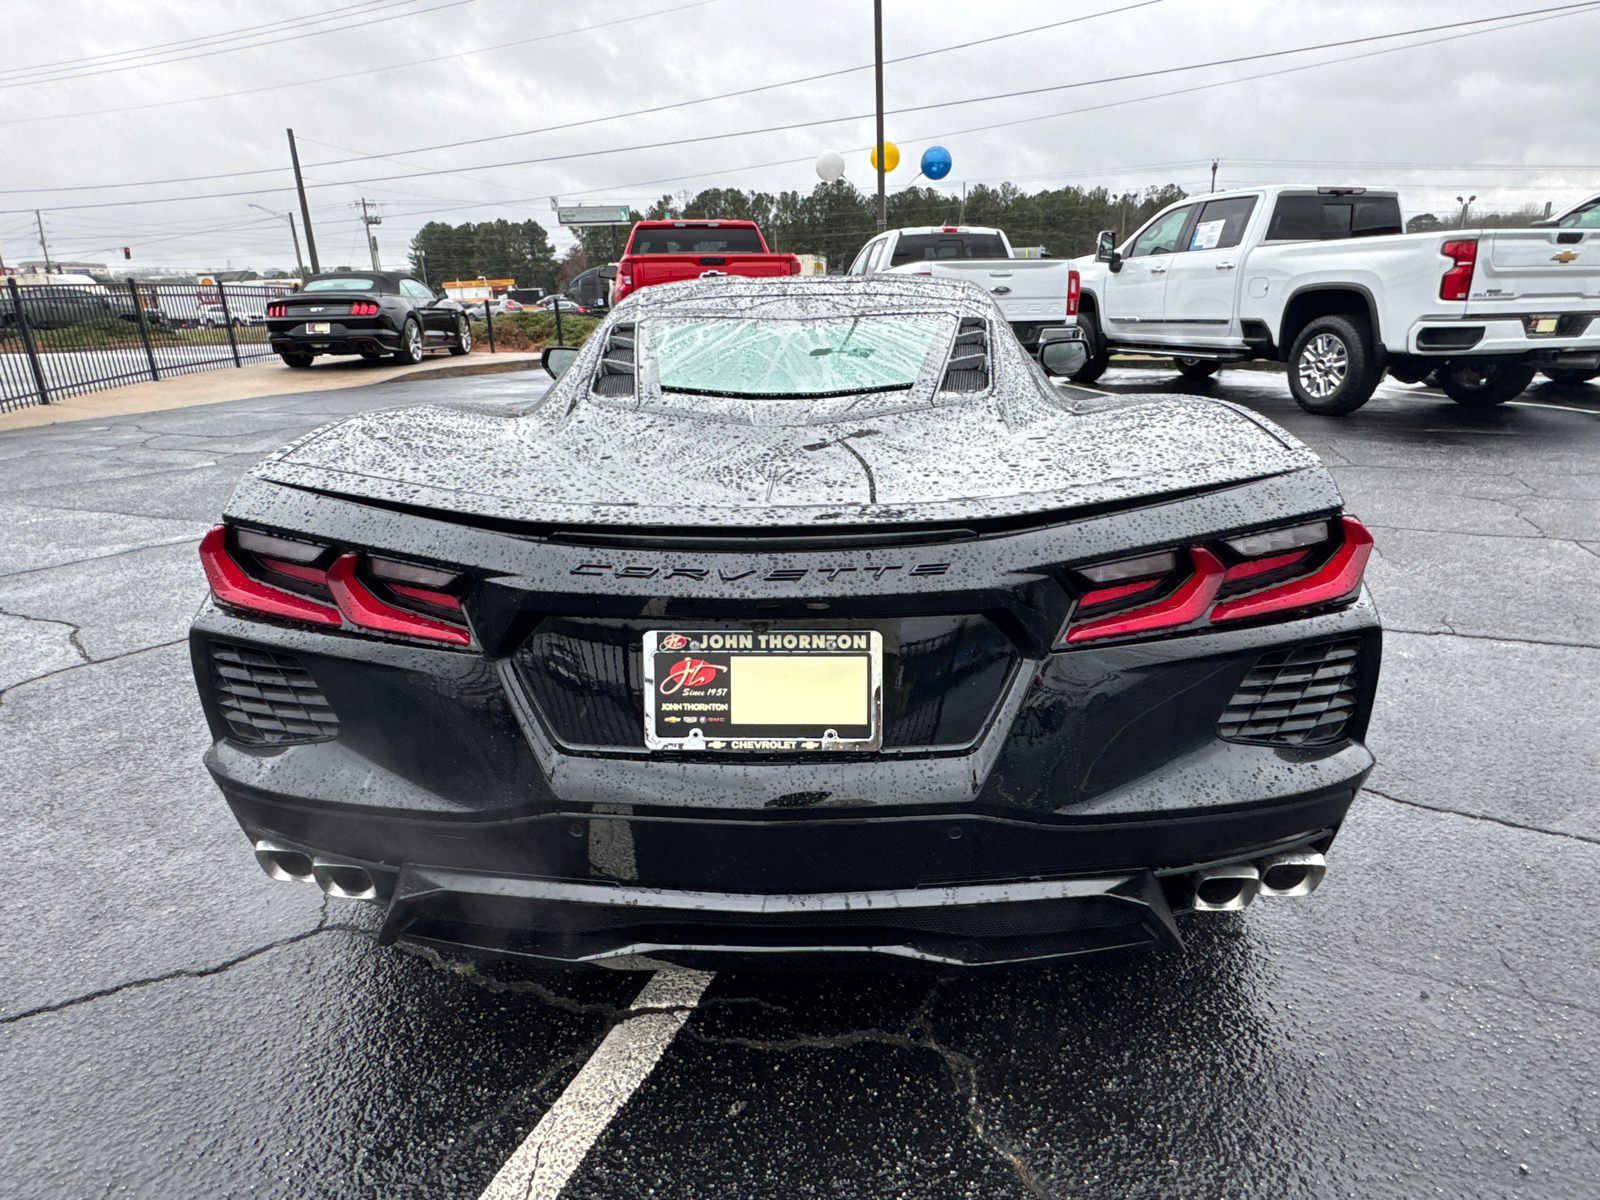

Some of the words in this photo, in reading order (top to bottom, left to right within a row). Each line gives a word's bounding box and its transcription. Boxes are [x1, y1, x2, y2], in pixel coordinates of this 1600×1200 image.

[569, 562, 952, 582] CORVETTE
[700, 634, 753, 649] JOHN
[682, 688, 705, 696] Since
[706, 688, 728, 696] 1957
[661, 703, 682, 711] JOHN
[683, 703, 728, 711] THORNTON
[731, 741, 797, 749] CHEVROLET
